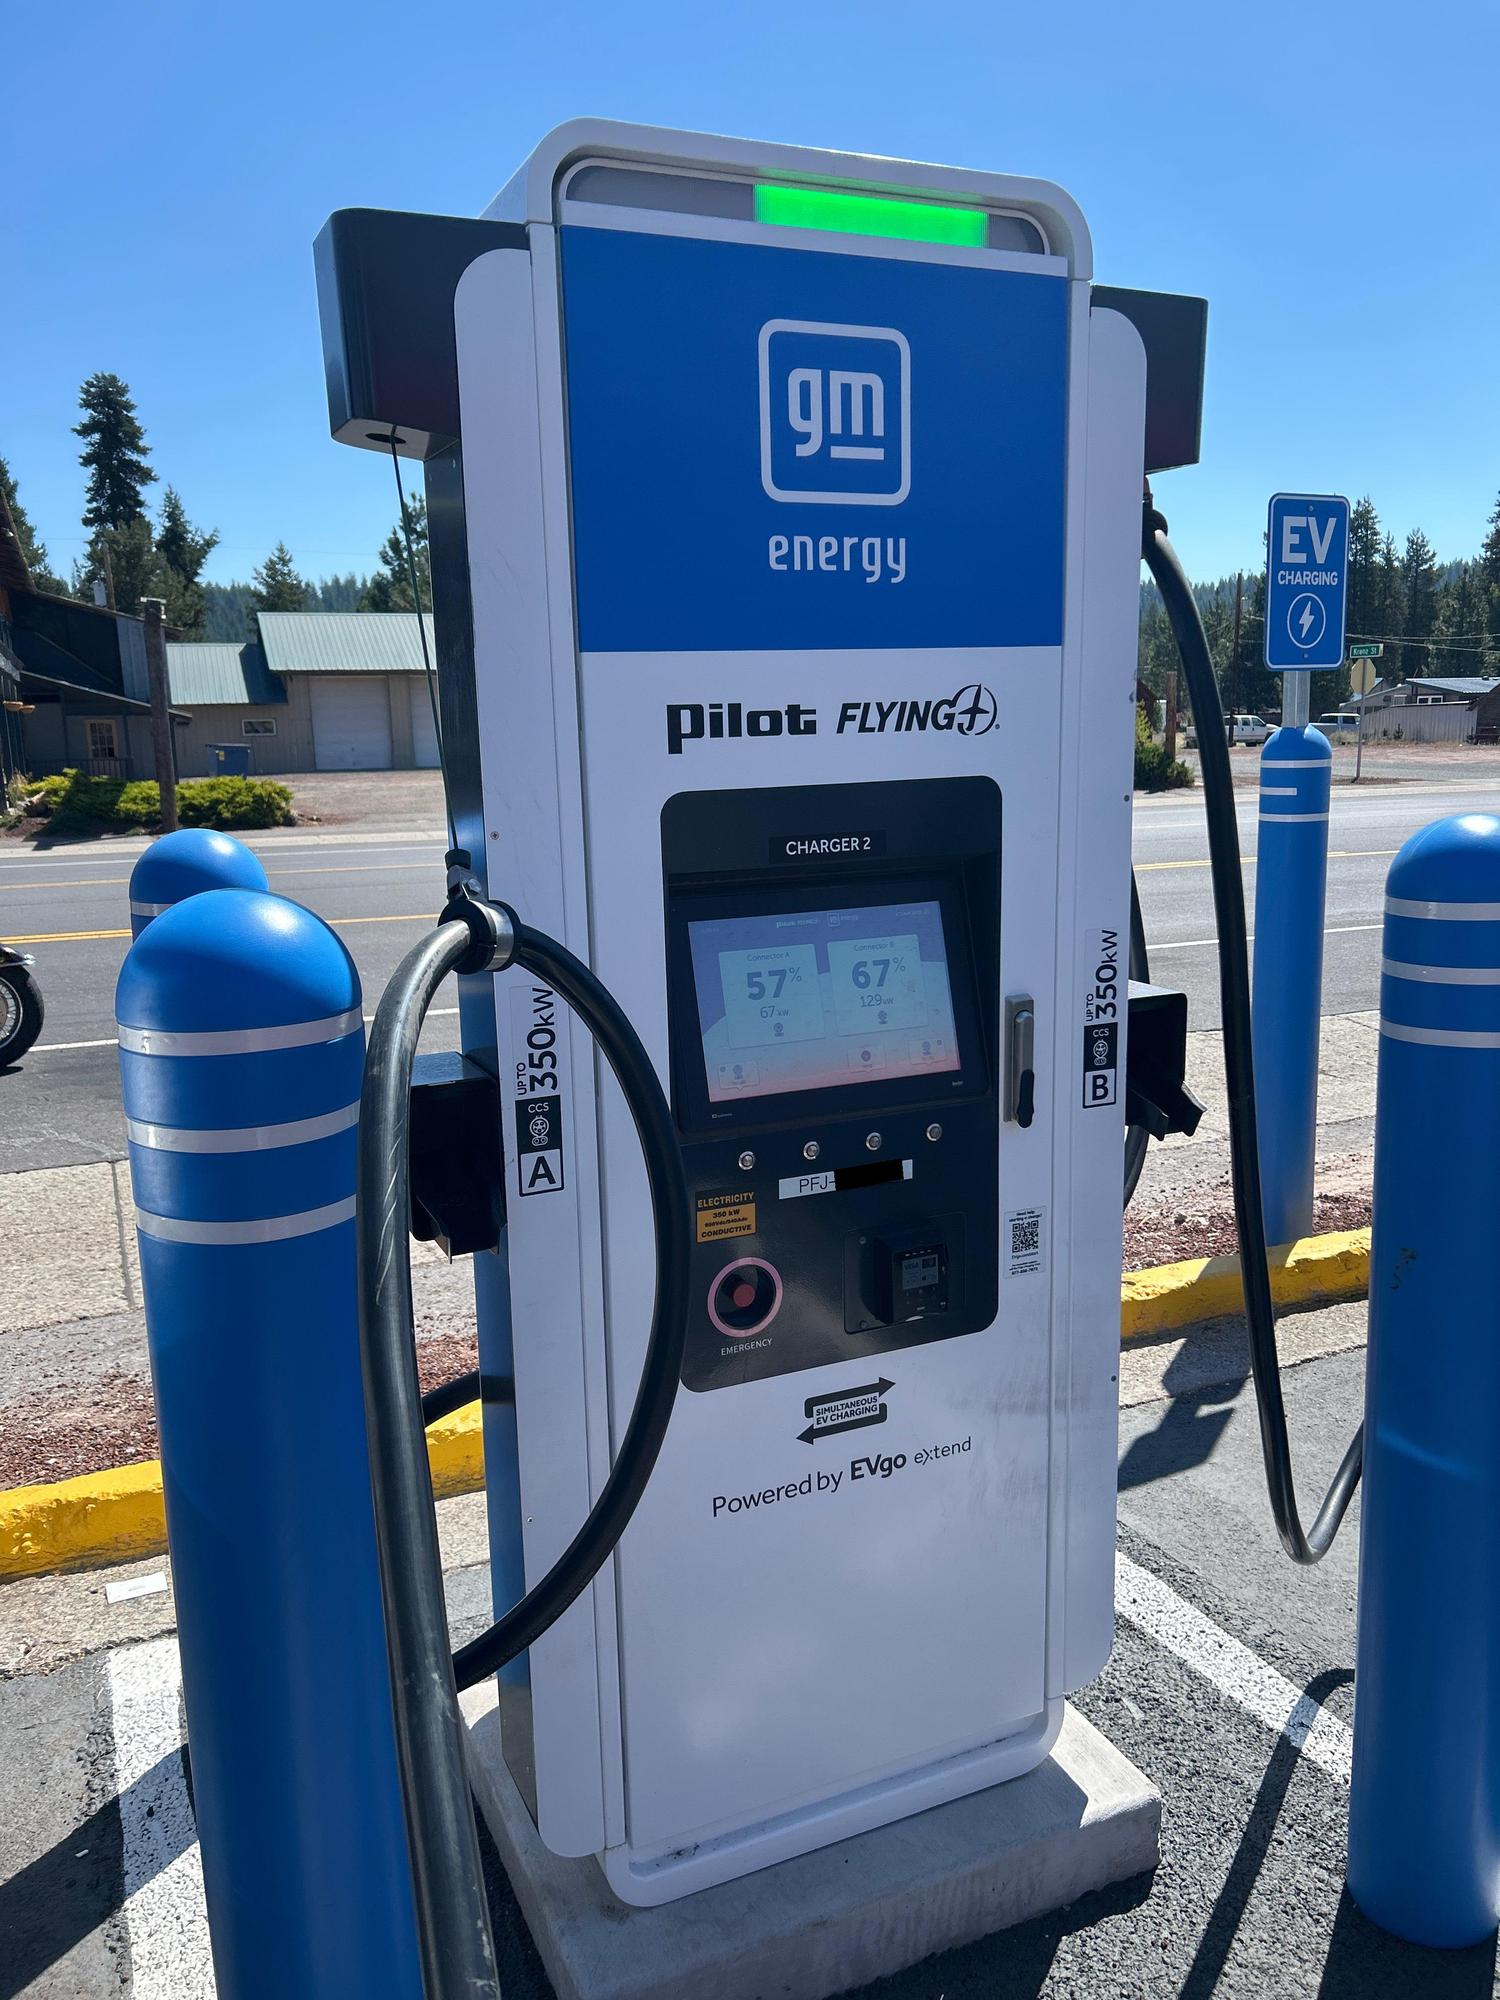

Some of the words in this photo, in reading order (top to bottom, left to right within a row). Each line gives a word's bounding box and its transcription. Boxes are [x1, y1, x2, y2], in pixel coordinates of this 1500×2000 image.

[788, 368, 884, 460] gm
[1282, 516, 1337, 564] EV
[768, 535, 906, 583] energy
[1278, 570, 1338, 586] CHARGING
[666, 702, 817, 754] pilot
[785, 838, 860, 855] CHARGER
[862, 837, 871, 850] 2
[1095, 930, 1118, 1019] 350kW
[1085, 993, 1094, 1008] TO
[1086, 1010, 1093, 1021] UP
[526, 987, 558, 1092] 350kW
[1093, 1028, 1109, 1037] CCS
[516, 1062, 526, 1079] TO
[517, 1081, 527, 1096] UP
[1092, 1074, 1108, 1101] B
[528, 1103, 549, 1113] CCS
[528, 1155, 556, 1188] A
[697, 1192, 754, 1208] ELECTRICITY
[701, 1224, 752, 1238] CONDUCTIVE
[721, 1338, 772, 1356] EMERGENCY
[816, 1396, 877, 1416] SIMULTANEOUS
[816, 1416, 828, 1425] EV
[830, 1404, 878, 1421] CHARGING
[712, 1474, 812, 1517] Powered
[817, 1470, 844, 1492] by
[850, 1453, 907, 1480] EVgo
